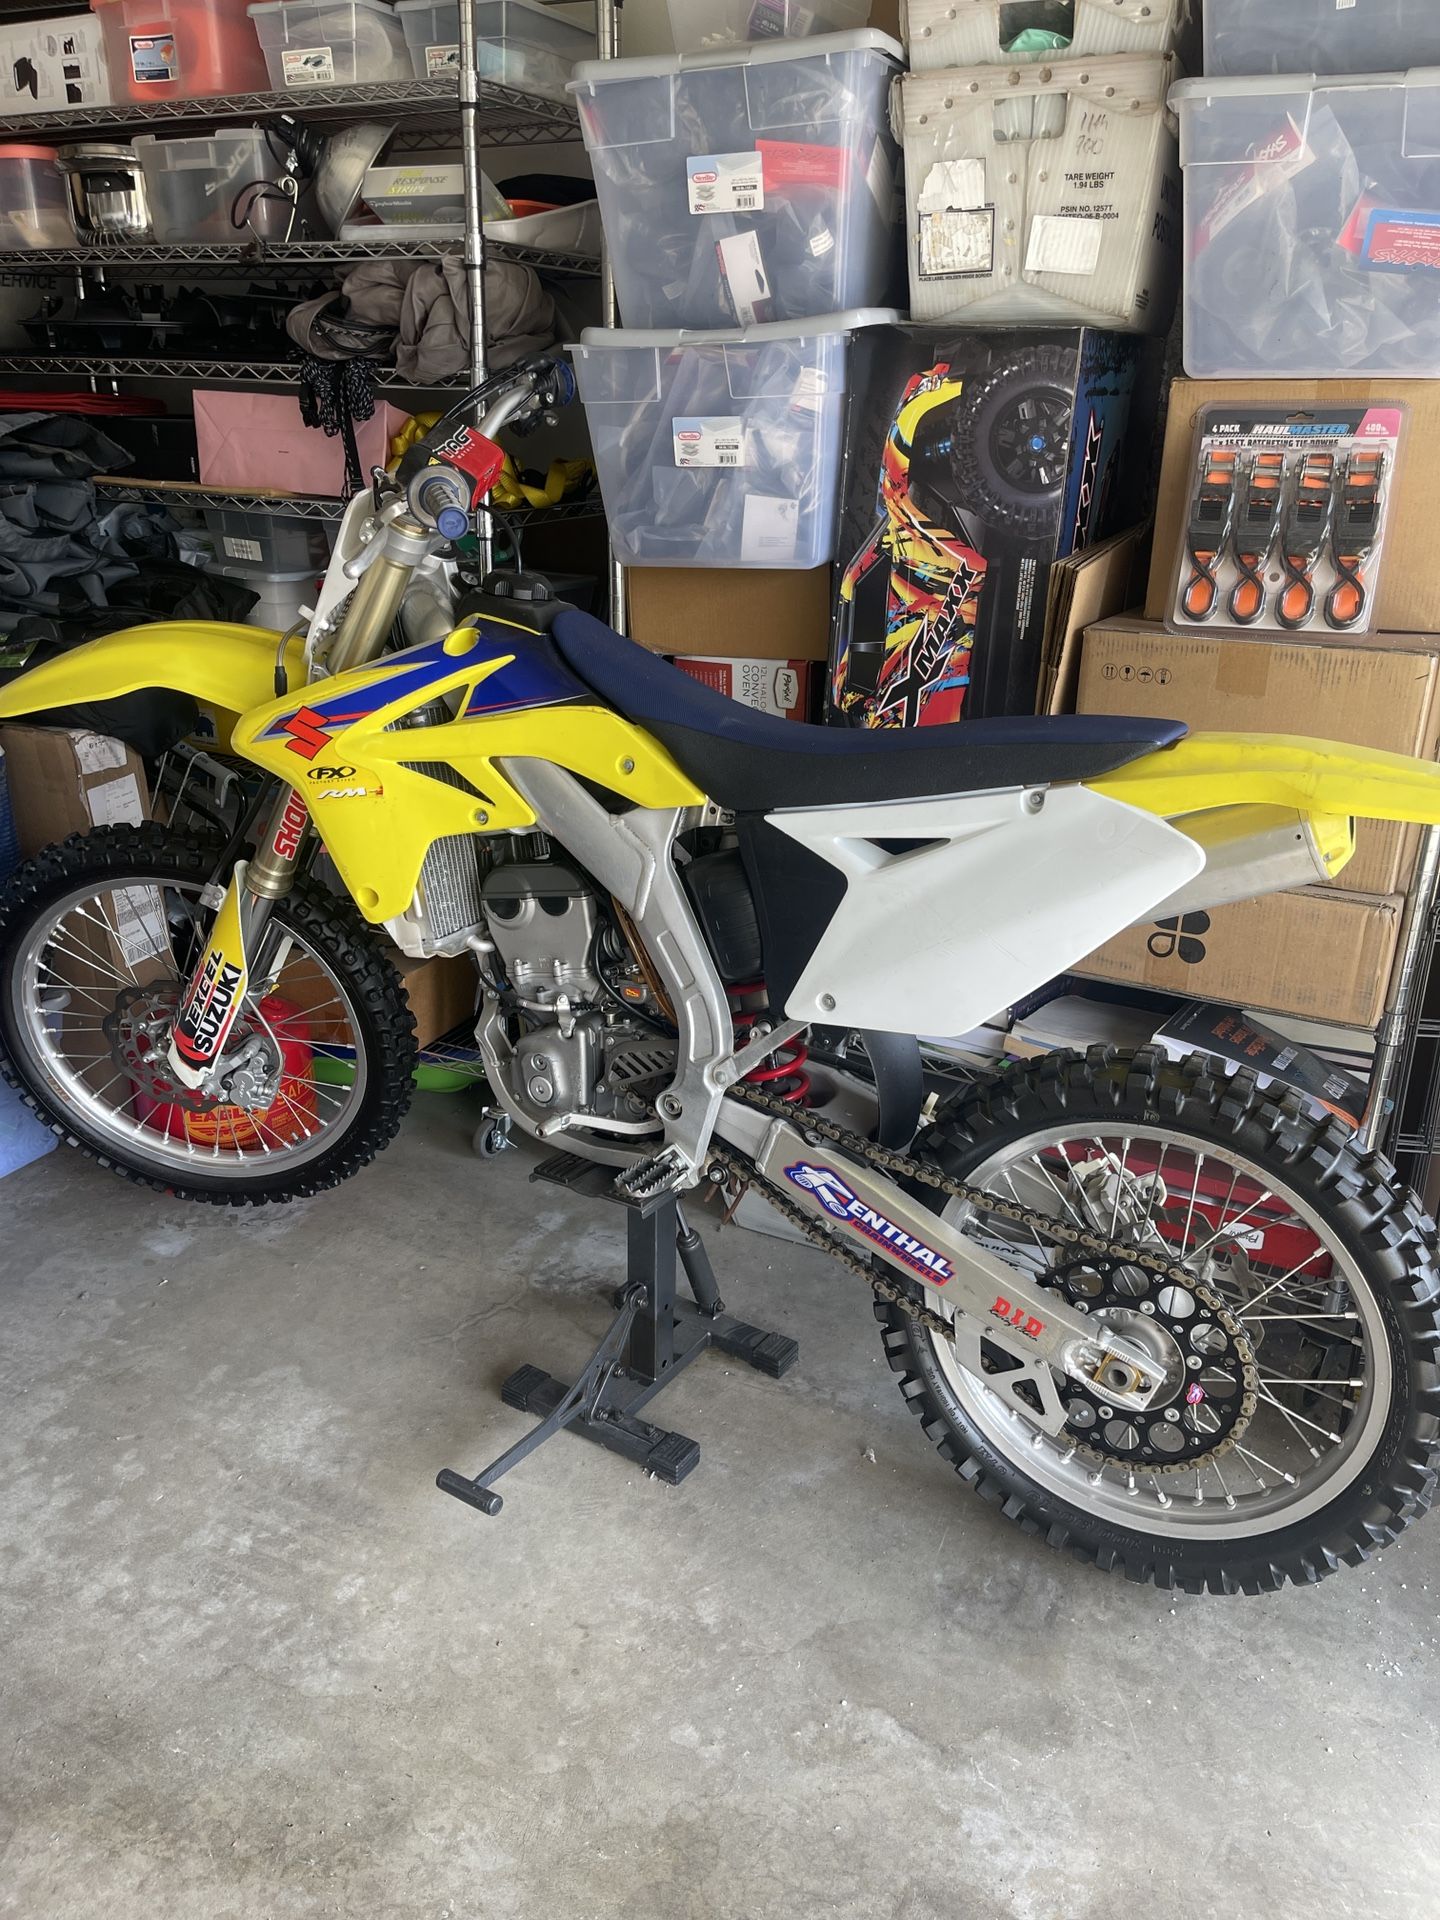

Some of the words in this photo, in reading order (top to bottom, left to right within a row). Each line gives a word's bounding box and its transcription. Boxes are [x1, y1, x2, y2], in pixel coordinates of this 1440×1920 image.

[1064, 172, 1083, 181] TARE
[1085, 171, 1115, 180] WEIGHT
[1089, 181, 1104, 189] LBS
[1060, 205, 1077, 213] PSIN
[1093, 204, 1113, 212] 1257T
[1212, 425, 1217, 433] 4
[1219, 424, 1240, 433] PACK
[742, 664, 750, 697] OVEN
[194, 961, 243, 1053] SUZUKI
[853, 1219, 944, 1284] CHAINWHEELS
[955, 1420, 969, 1434] NOT
